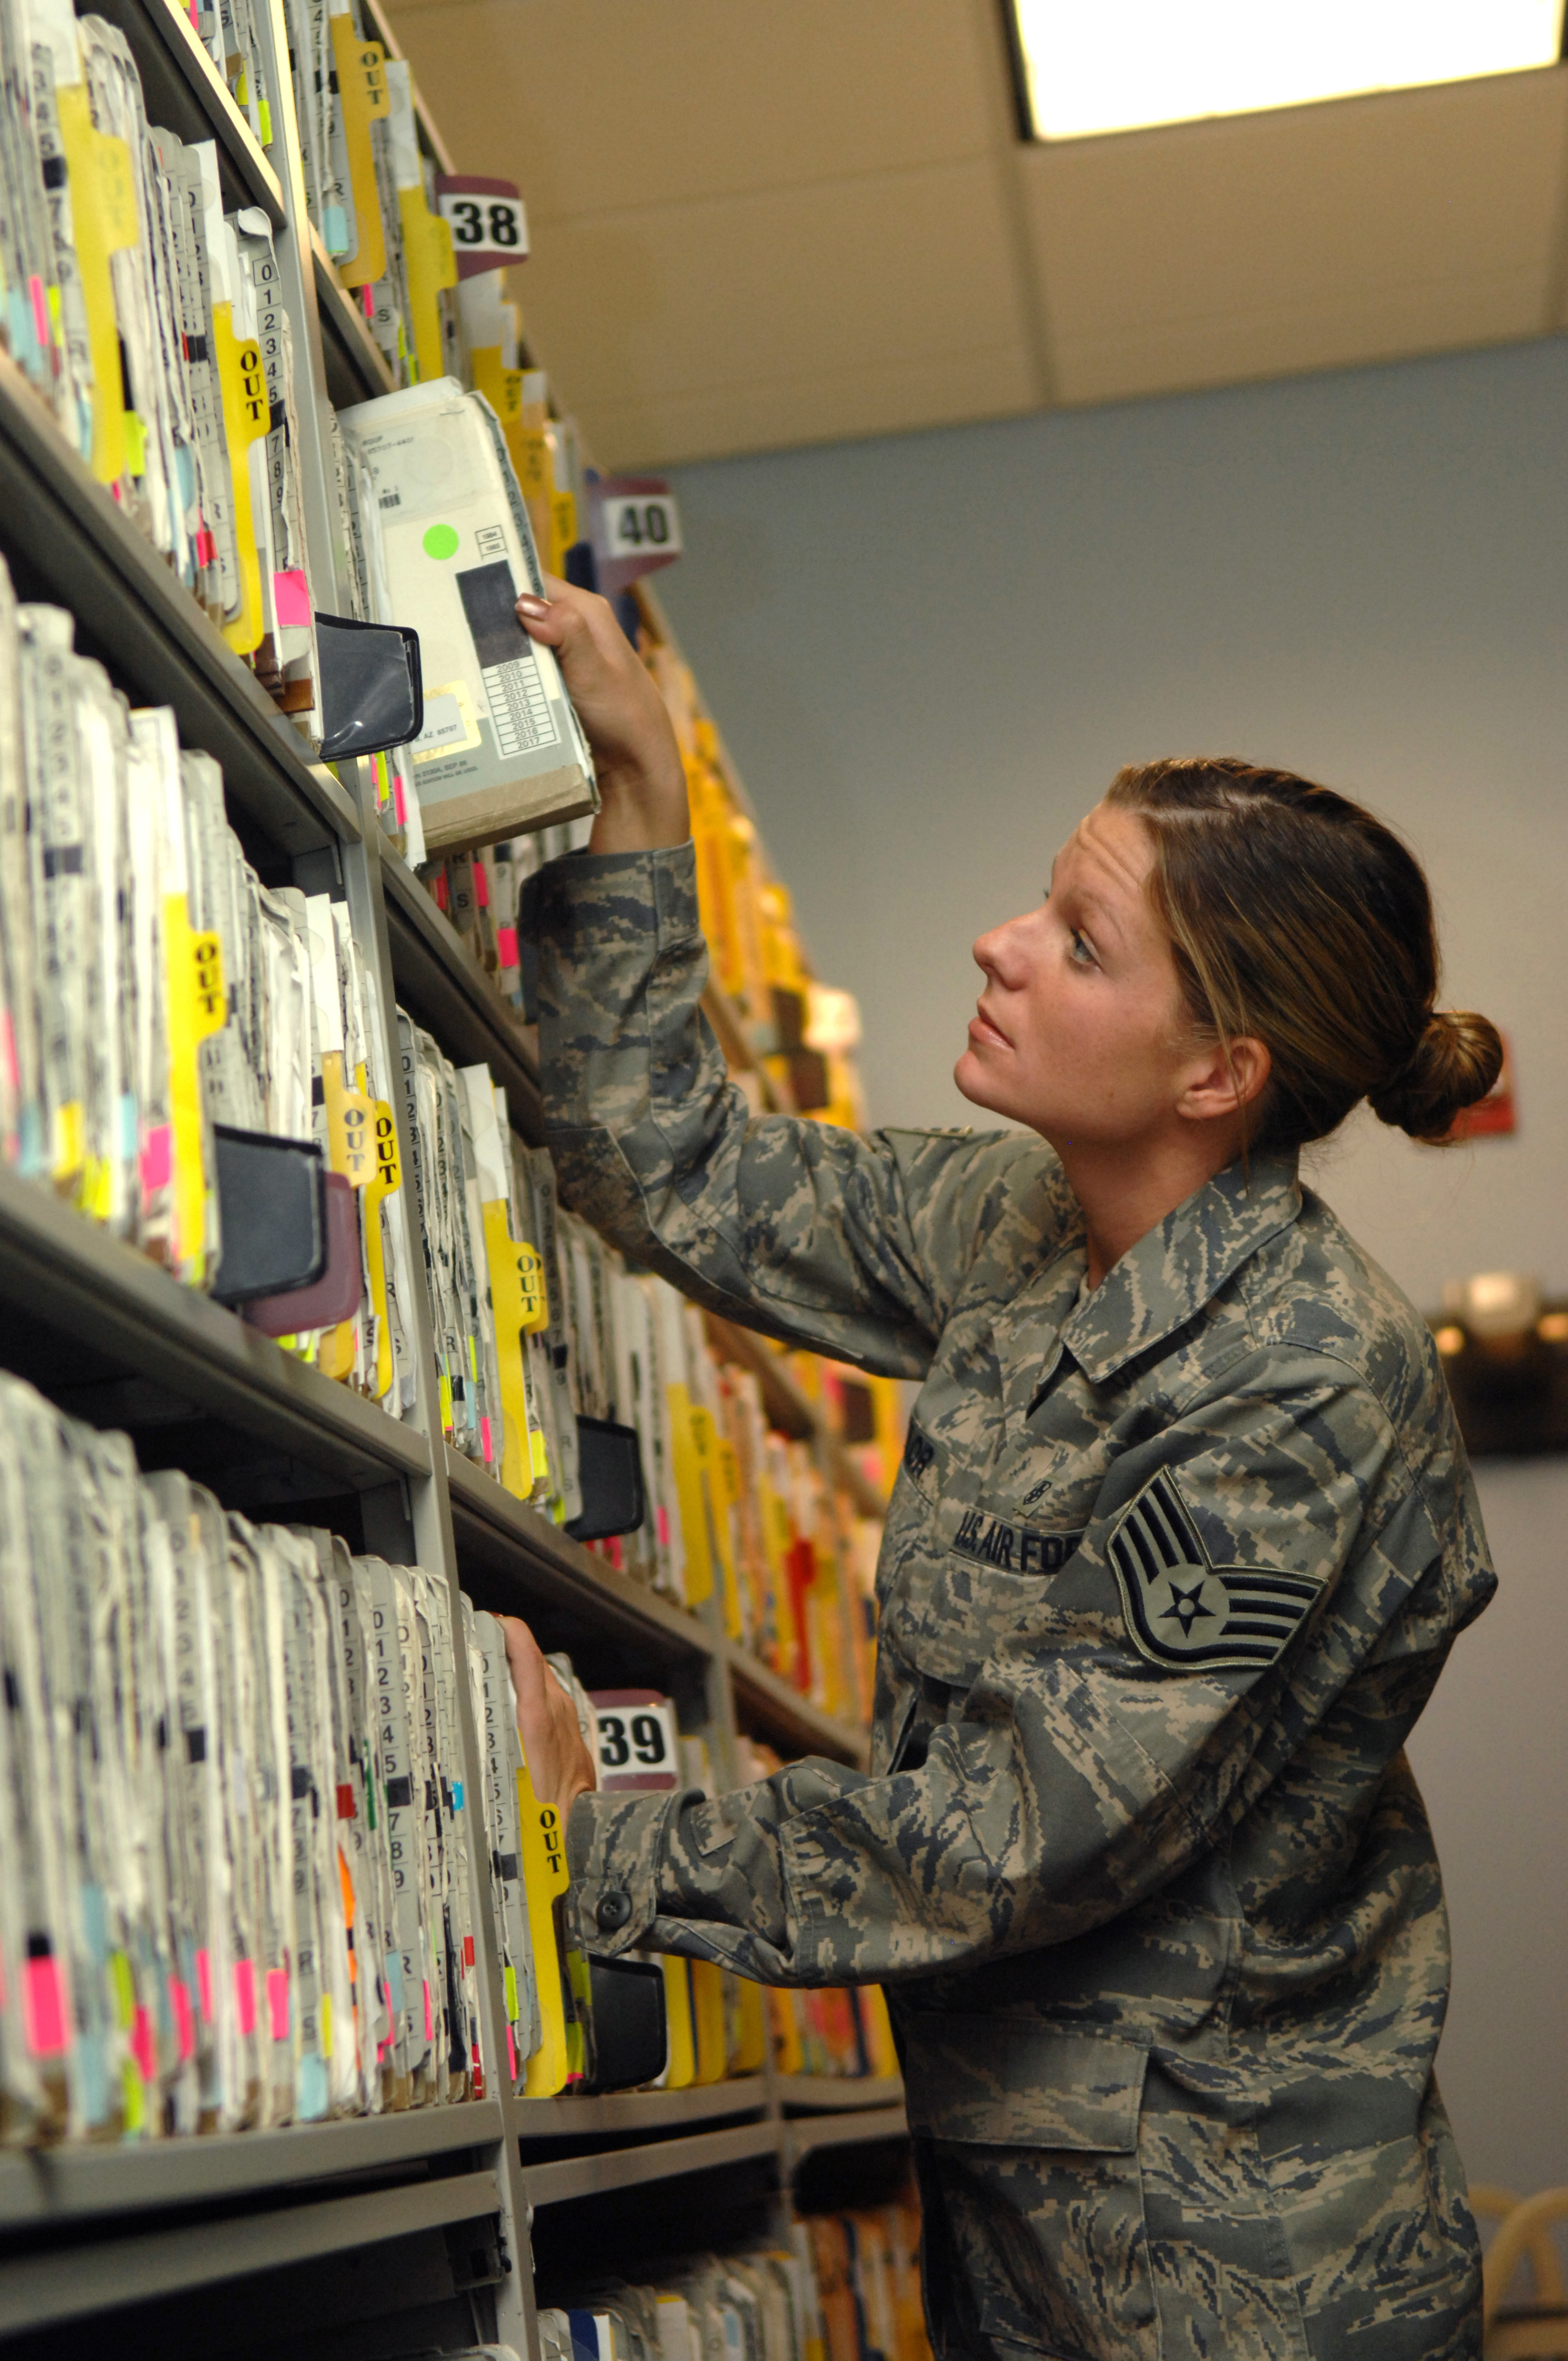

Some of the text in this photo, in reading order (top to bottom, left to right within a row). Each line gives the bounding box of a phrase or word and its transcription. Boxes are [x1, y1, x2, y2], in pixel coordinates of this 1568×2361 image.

[362, 51, 383, 105] OUT
[453, 202, 519, 246] 38
[262, 264, 272, 281] 0
[264, 289, 271, 304] 1
[264, 313, 275, 330] 2
[378, 309, 390, 322] S
[266, 338, 276, 354] 3
[267, 362, 276, 377] 4
[240, 350, 263, 421] OUT
[269, 385, 277, 402] 5
[271, 435, 279, 453] 7
[275, 461, 281, 478] 8
[497, 448, 506, 462] 0
[503, 470, 510, 483] 1
[508, 491, 516, 505] 2
[514, 513, 522, 527] 3
[620, 505, 668, 545] 40
[496, 661, 520, 673] 2009
[499, 670, 522, 682] 2010
[502, 680, 525, 692] 2011
[504, 689, 527, 701] 2012
[507, 699, 530, 711] 2013
[509, 709, 533, 721] 2014
[437, 724, 457, 735] 85707
[512, 718, 536, 730] 2015
[515, 727, 538, 739] 2016
[517, 737, 540, 749] 2017
[195, 942, 221, 1014] OUT
[402, 1056, 411, 1071] 0
[404, 1079, 410, 1095] 1
[407, 1103, 415, 1119] 2
[344, 1109, 365, 1171] OUT
[377, 1117, 396, 1184] OUT
[517, 1255, 537, 1312] OUT
[447, 1335, 455, 1351] R
[977, 1520, 1014, 1570] AIR
[341, 1589, 350, 1608] 0
[342, 1619, 349, 1636] 1
[374, 1611, 384, 1629] 0
[375, 1639, 384, 1657] 1
[345, 1649, 353, 1666] 2
[378, 1668, 388, 1685] 2
[380, 1696, 390, 1715] 3
[485, 1707, 493, 1723] 2
[383, 1724, 394, 1743] 4
[487, 1732, 496, 1749] 3
[598, 1714, 665, 1766] 39
[385, 1755, 396, 1774] 5
[388, 1813, 400, 1831] 7
[391, 1841, 403, 1859] 8
[540, 1809, 562, 1874] OUT
[394, 1870, 404, 1888] 9
